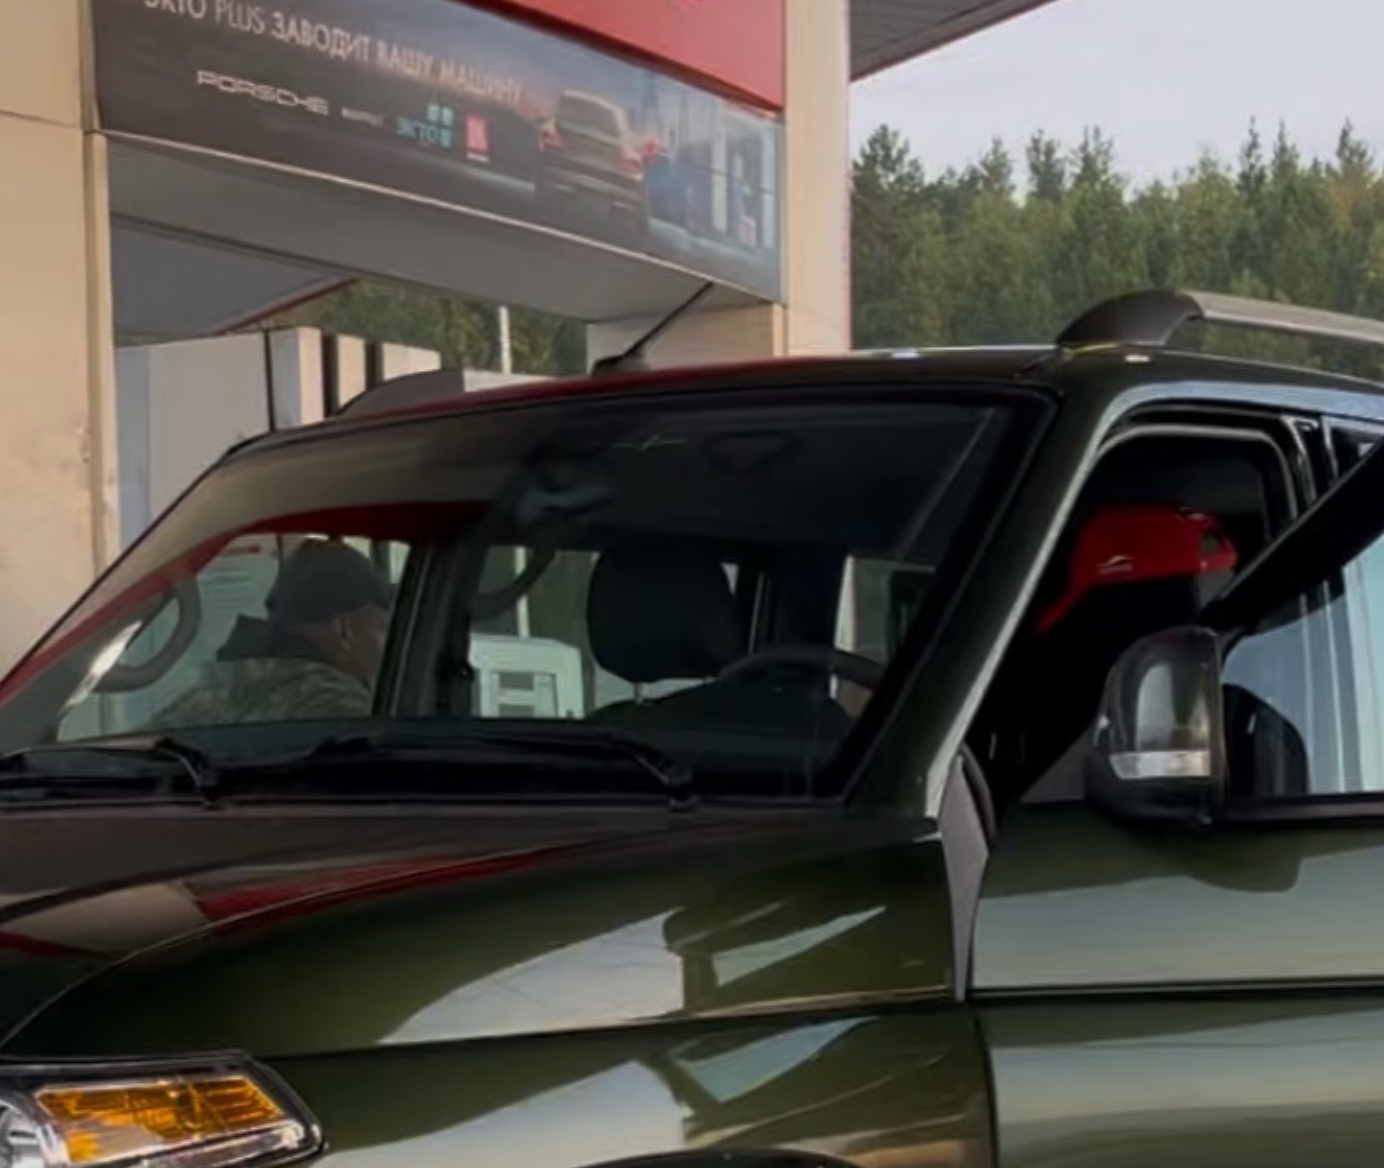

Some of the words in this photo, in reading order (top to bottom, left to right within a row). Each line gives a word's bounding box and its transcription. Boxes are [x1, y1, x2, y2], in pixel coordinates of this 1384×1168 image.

[215, 0, 266, 34] PLUS
[271, 11, 370, 61] ЗАВОДИТ
[197, 70, 329, 115] PORSCHE
